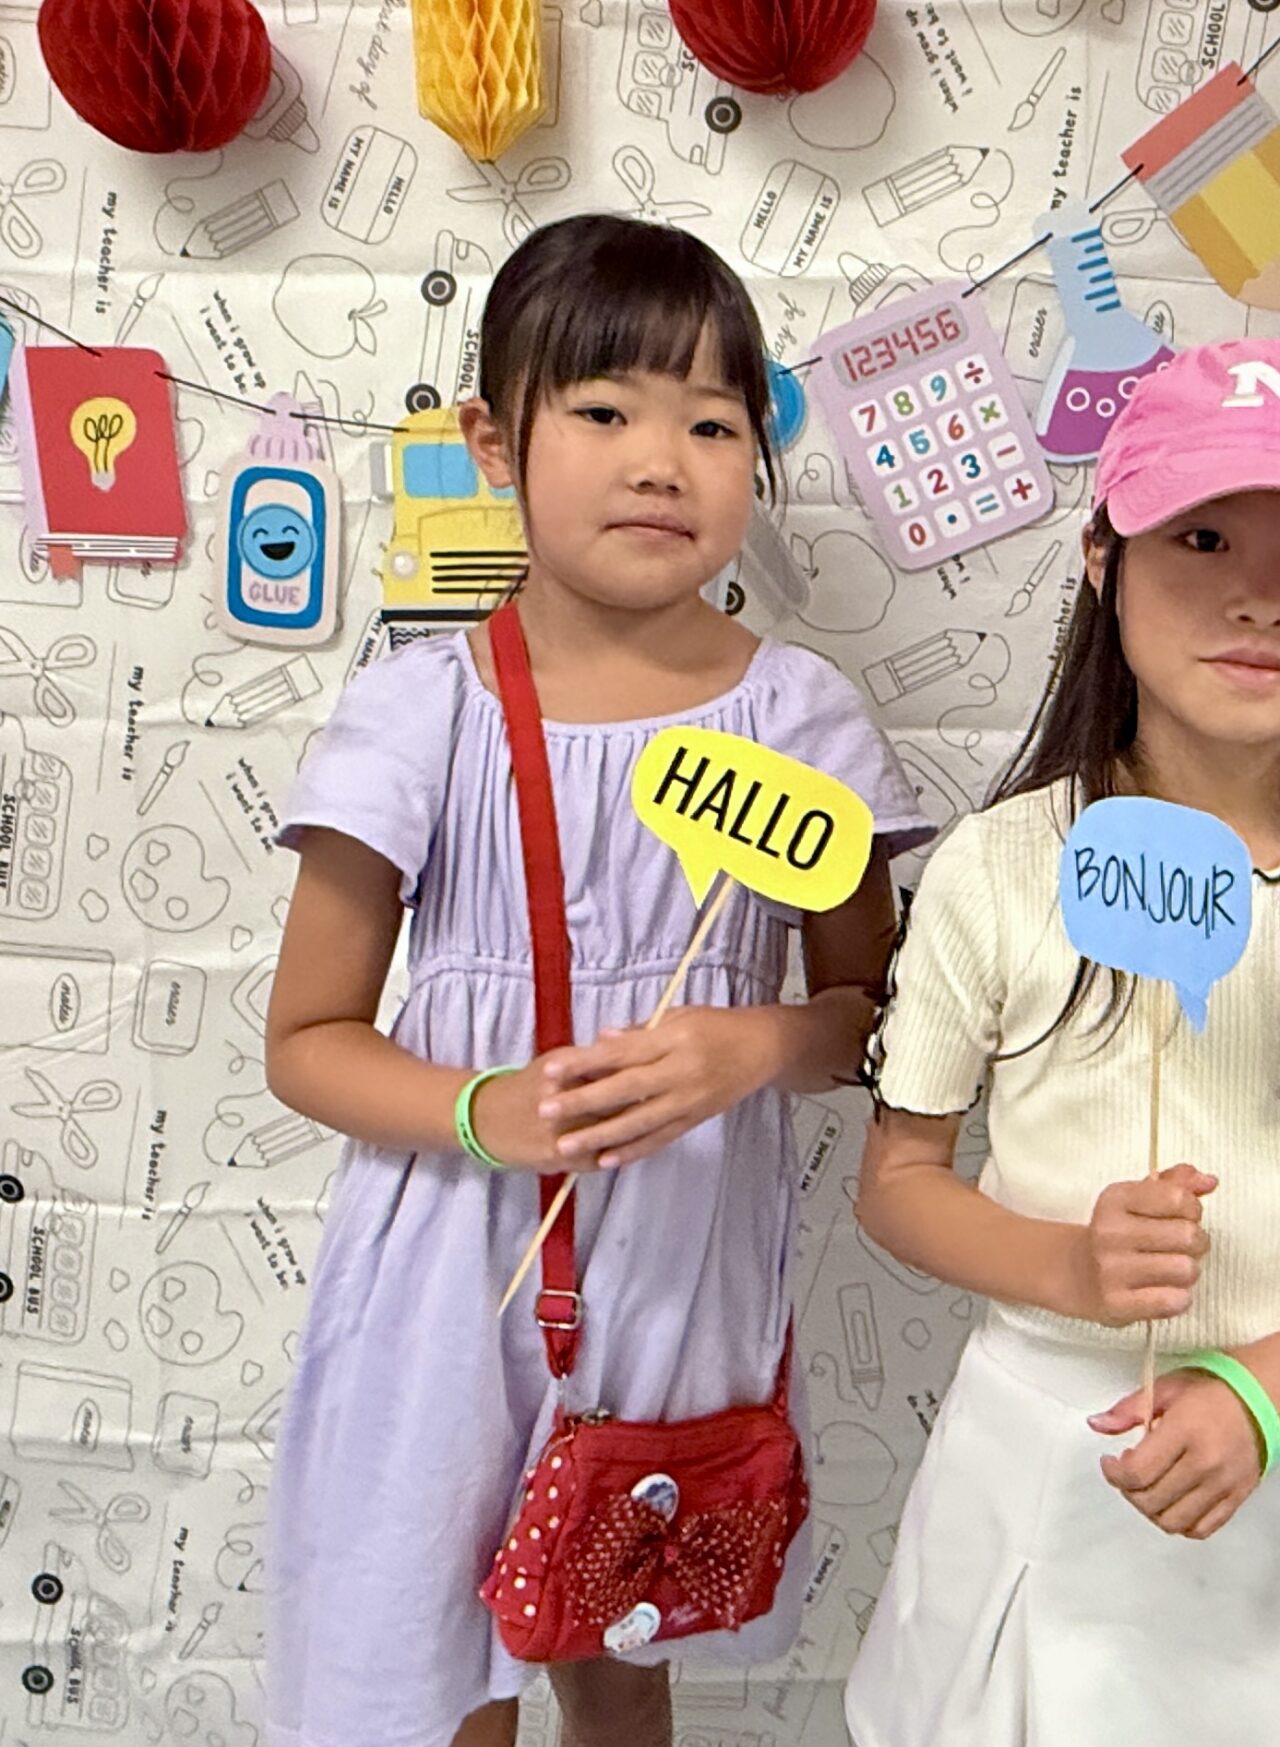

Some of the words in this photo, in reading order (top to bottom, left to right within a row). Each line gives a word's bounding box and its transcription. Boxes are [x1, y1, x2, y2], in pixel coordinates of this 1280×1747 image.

[905, 8, 919, 27] up
[936, 27, 949, 46] to
[1201, 3, 1226, 70] SCHOOL
[348, 81, 378, 111] of
[1065, 86, 1082, 101] is
[349, 136, 365, 158] MY
[1052, 109, 1077, 177] teacher
[334, 159, 356, 194] NAME
[383, 175, 405, 215] HELLO
[101, 191, 117, 219] my
[327, 196, 341, 211] IS
[753, 190, 777, 229] HELLO
[1050, 187, 1067, 210] my
[792, 247, 808, 269] MY
[803, 211, 827, 247] NAME
[819, 194, 833, 209] IS
[96, 228, 118, 293] teacher
[95, 300, 112, 314] is
[223, 353, 236, 371] to
[457, 329, 480, 393] SCHOOL
[843, 308, 961, 382] 123456
[858, 404, 877, 432] 7
[893, 390, 914, 416] 8
[929, 375, 947, 401] 9
[876, 444, 895, 469] 4
[908, 429, 930, 455] 5
[947, 413, 965, 440] 6
[892, 484, 912, 508] 1
[927, 468, 949, 495] 2
[960, 453, 981, 479] 3
[908, 522, 927, 546] 0
[249, 580, 301, 607] GLUE
[127, 665, 144, 692] my
[124, 700, 145, 760] teacher
[651, 746, 836, 871] HALLO
[1074, 846, 1236, 940] BONJOUR
[150, 1109, 167, 1134] my
[144, 1143, 167, 1202] teacher
[29, 1226, 46, 1281] SCHOOL
